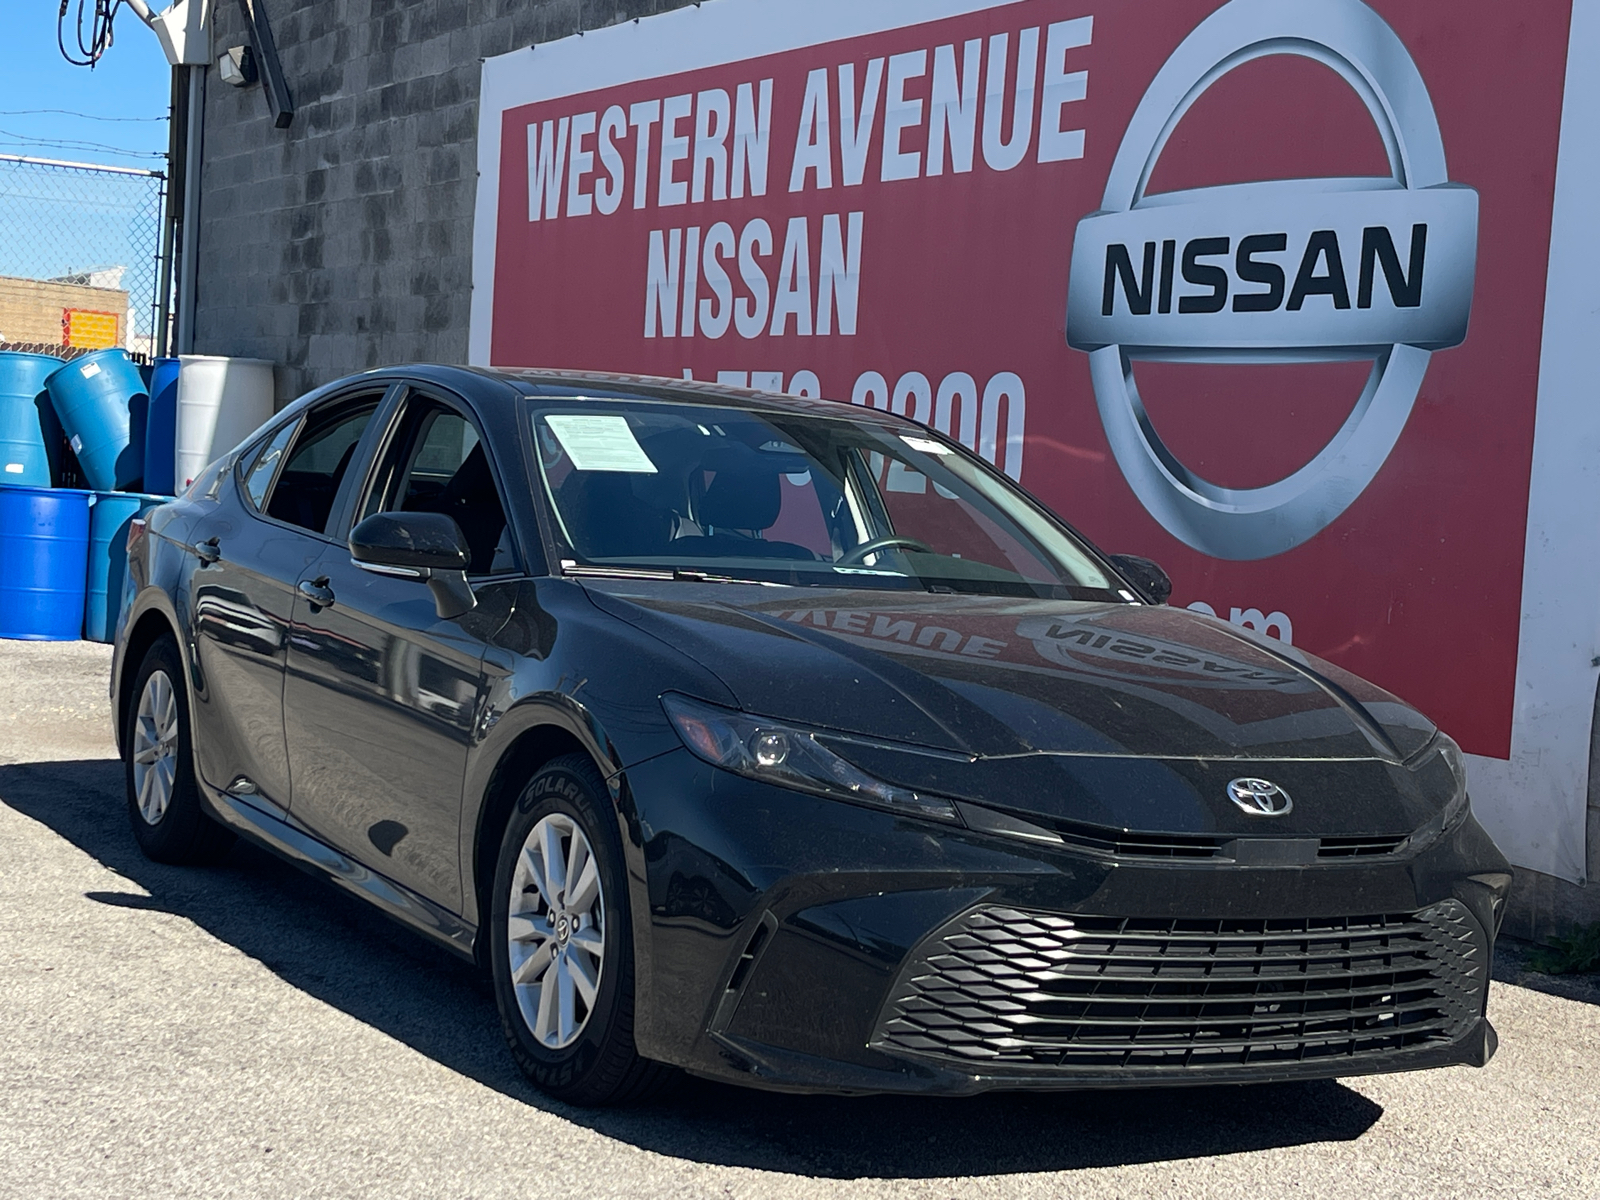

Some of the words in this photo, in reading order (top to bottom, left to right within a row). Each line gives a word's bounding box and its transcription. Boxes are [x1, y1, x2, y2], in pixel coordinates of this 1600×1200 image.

[526, 78, 773, 222] WESTERN
[788, 15, 1094, 193] AVENUE
[643, 211, 864, 339] NISSAN
[1101, 223, 1428, 316] NISSAN
[523, 775, 600, 827] SOLARUS
